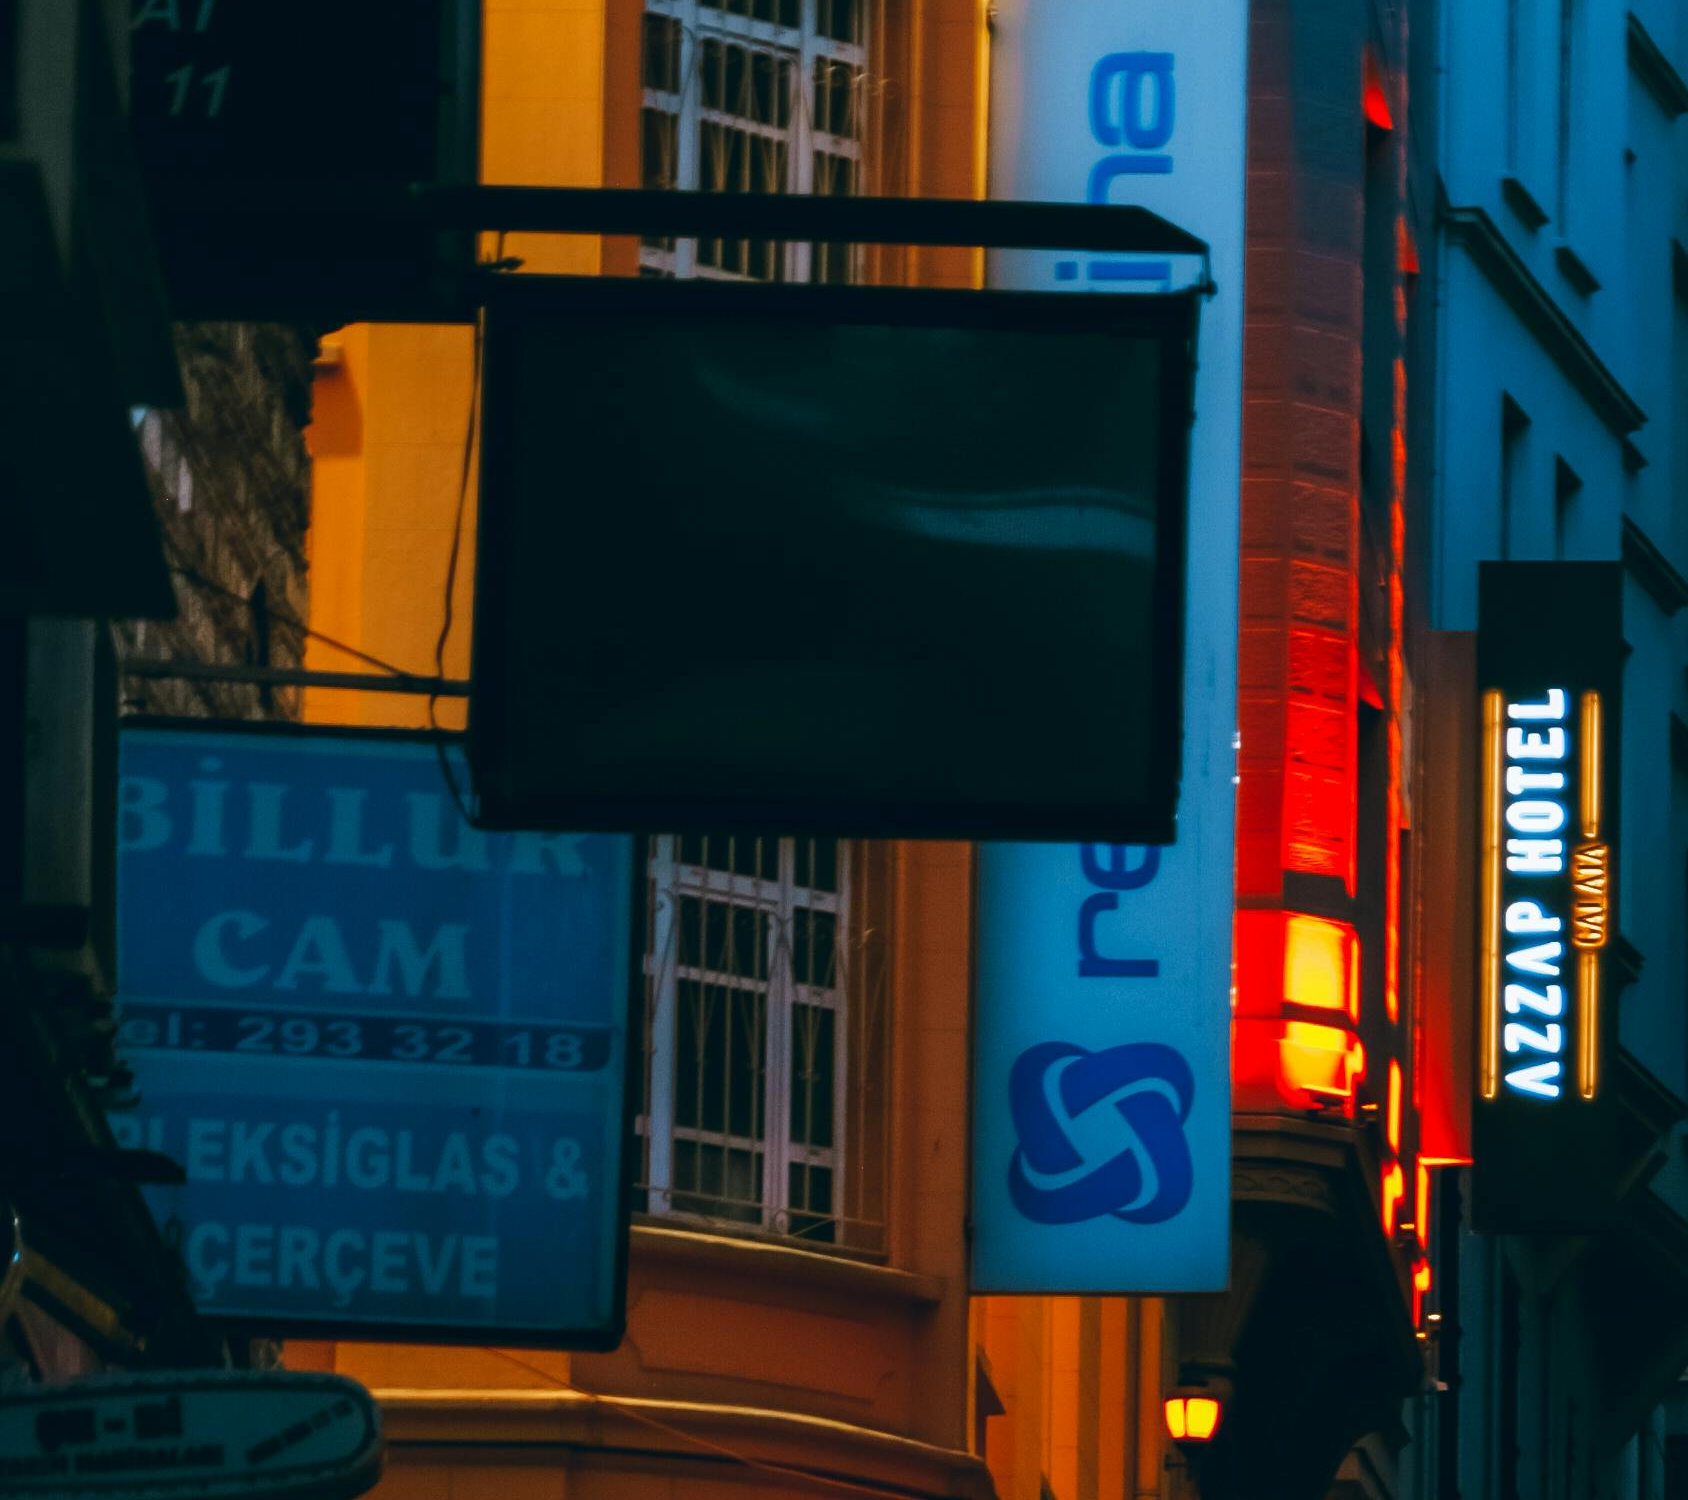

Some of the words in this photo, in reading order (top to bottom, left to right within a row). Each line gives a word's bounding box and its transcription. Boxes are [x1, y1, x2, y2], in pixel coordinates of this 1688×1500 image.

[1504, 687, 1566, 873] HOTEL
[1572, 842, 1608, 949] GALATA
[194, 910, 473, 998] CAM
[237, 1016, 363, 1058] 293
[394, 1025, 472, 1061] 32
[506, 1031, 584, 1068] 18
[547, 1134, 593, 1199] &
